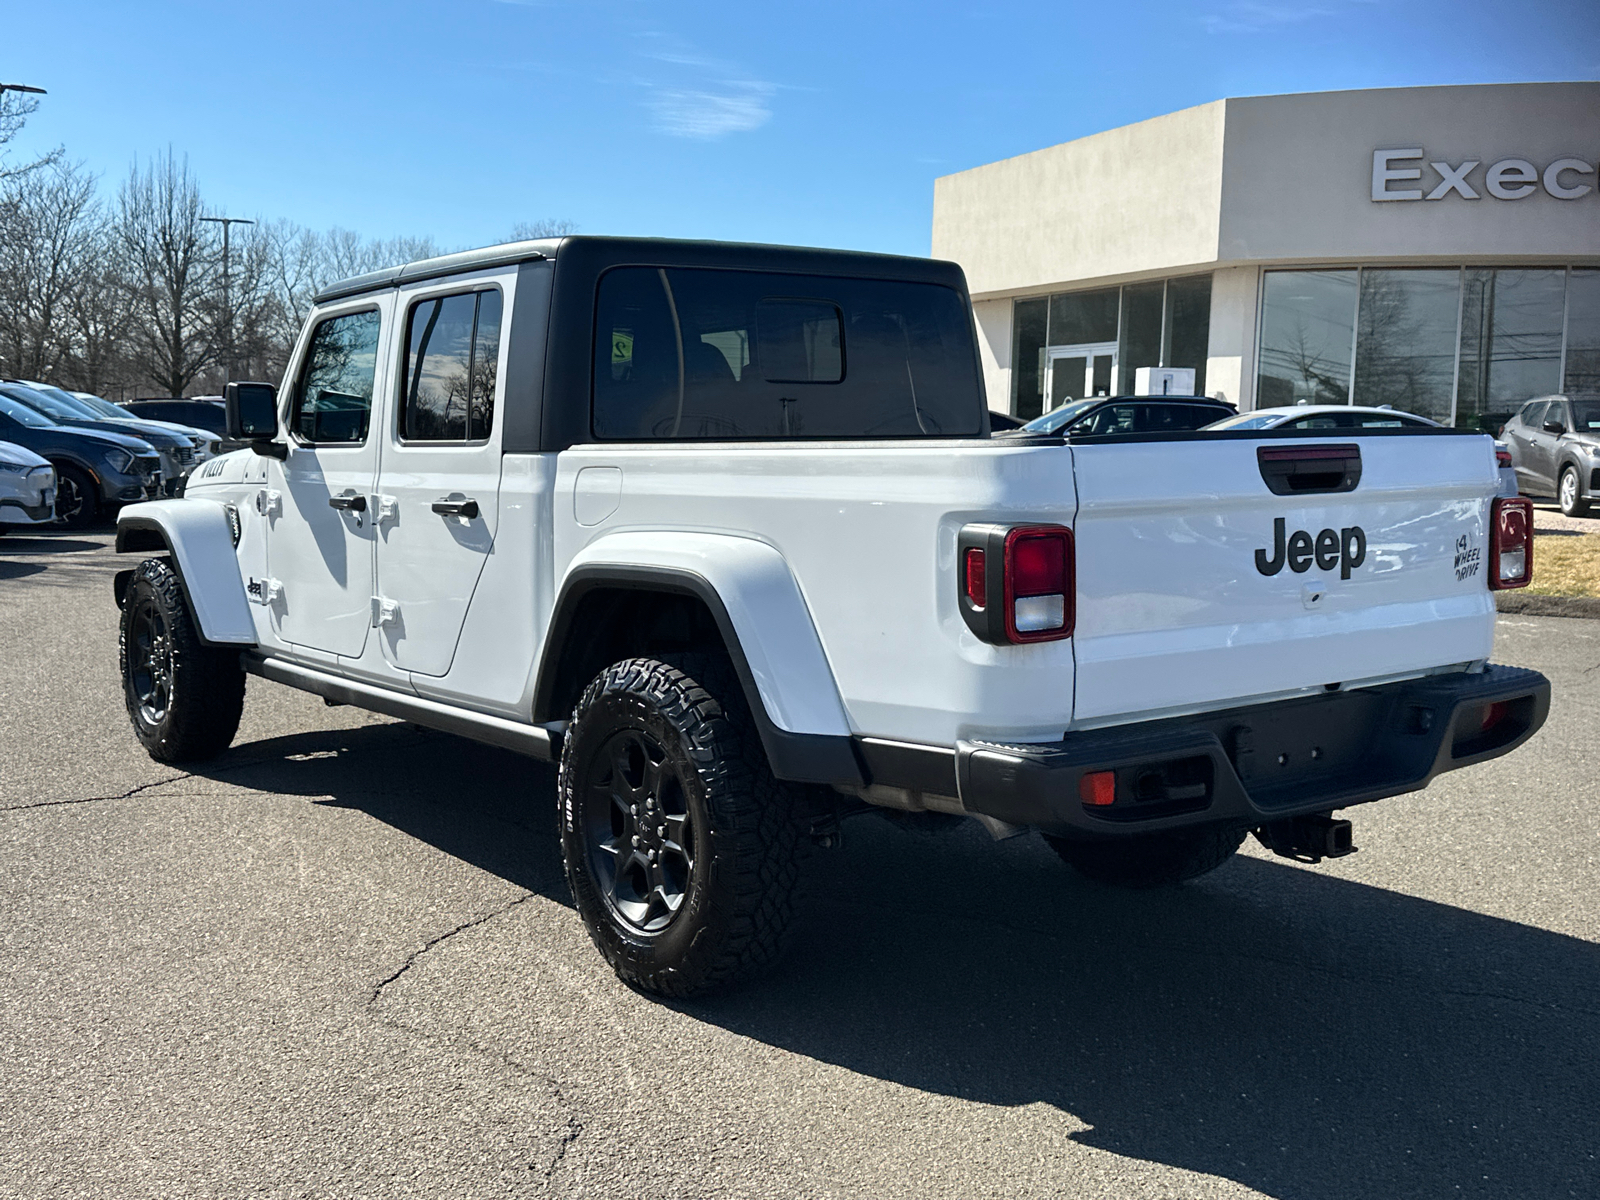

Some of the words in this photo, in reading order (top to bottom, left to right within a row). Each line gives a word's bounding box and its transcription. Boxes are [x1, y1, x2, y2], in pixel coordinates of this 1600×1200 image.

[1371, 148, 1600, 202] Exec
[1254, 517, 1367, 581] Jeep
[1453, 547, 1480, 569] WHEEL
